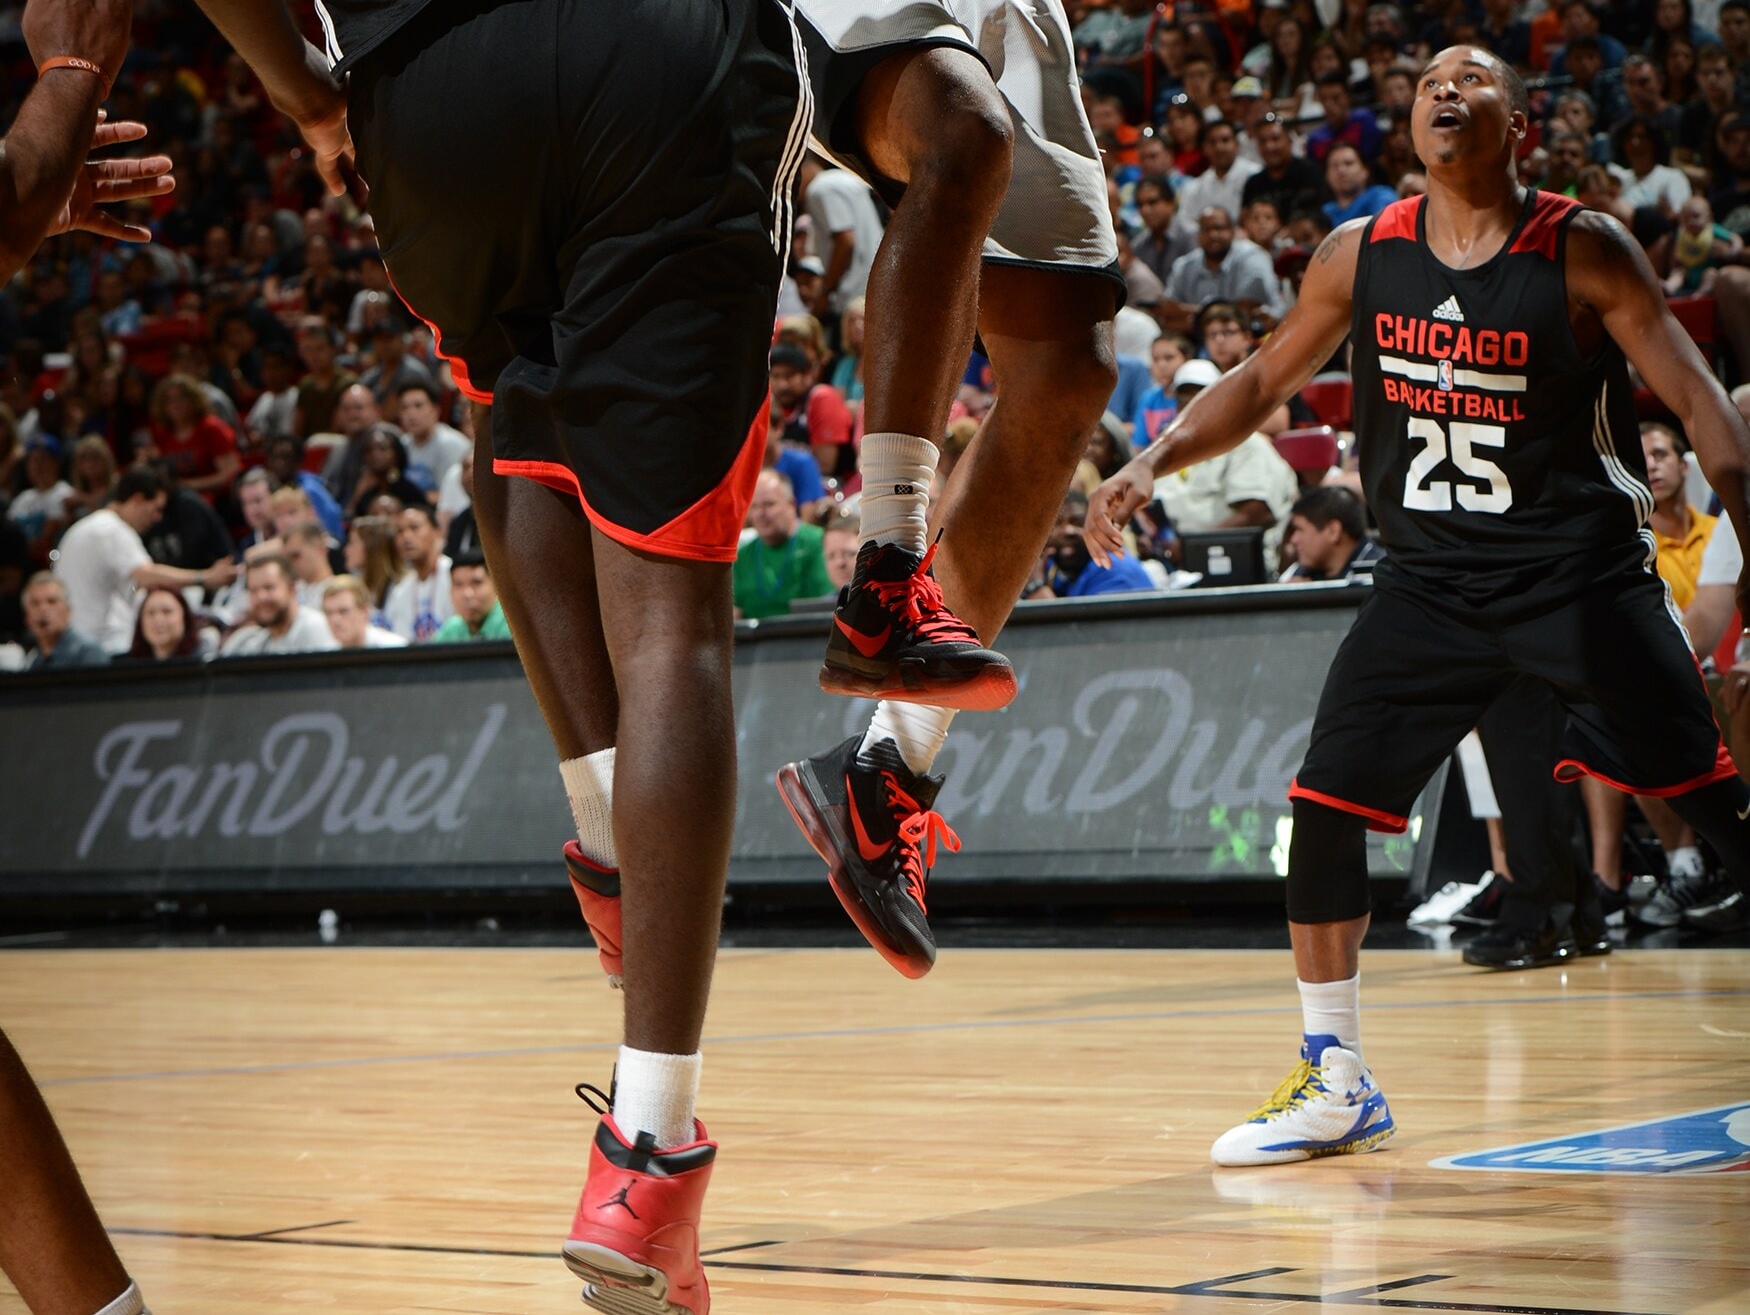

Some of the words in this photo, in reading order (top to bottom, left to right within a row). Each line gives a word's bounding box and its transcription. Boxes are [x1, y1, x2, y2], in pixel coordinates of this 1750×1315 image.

[68, 58, 91, 69] GOD
[1432, 308, 1465, 323] adidas
[1375, 312, 1530, 367] CHICAGO
[1402, 415, 1514, 515] 25
[76, 702, 508, 861] FanDuel
[1488, 1146, 1727, 1166] NBA
